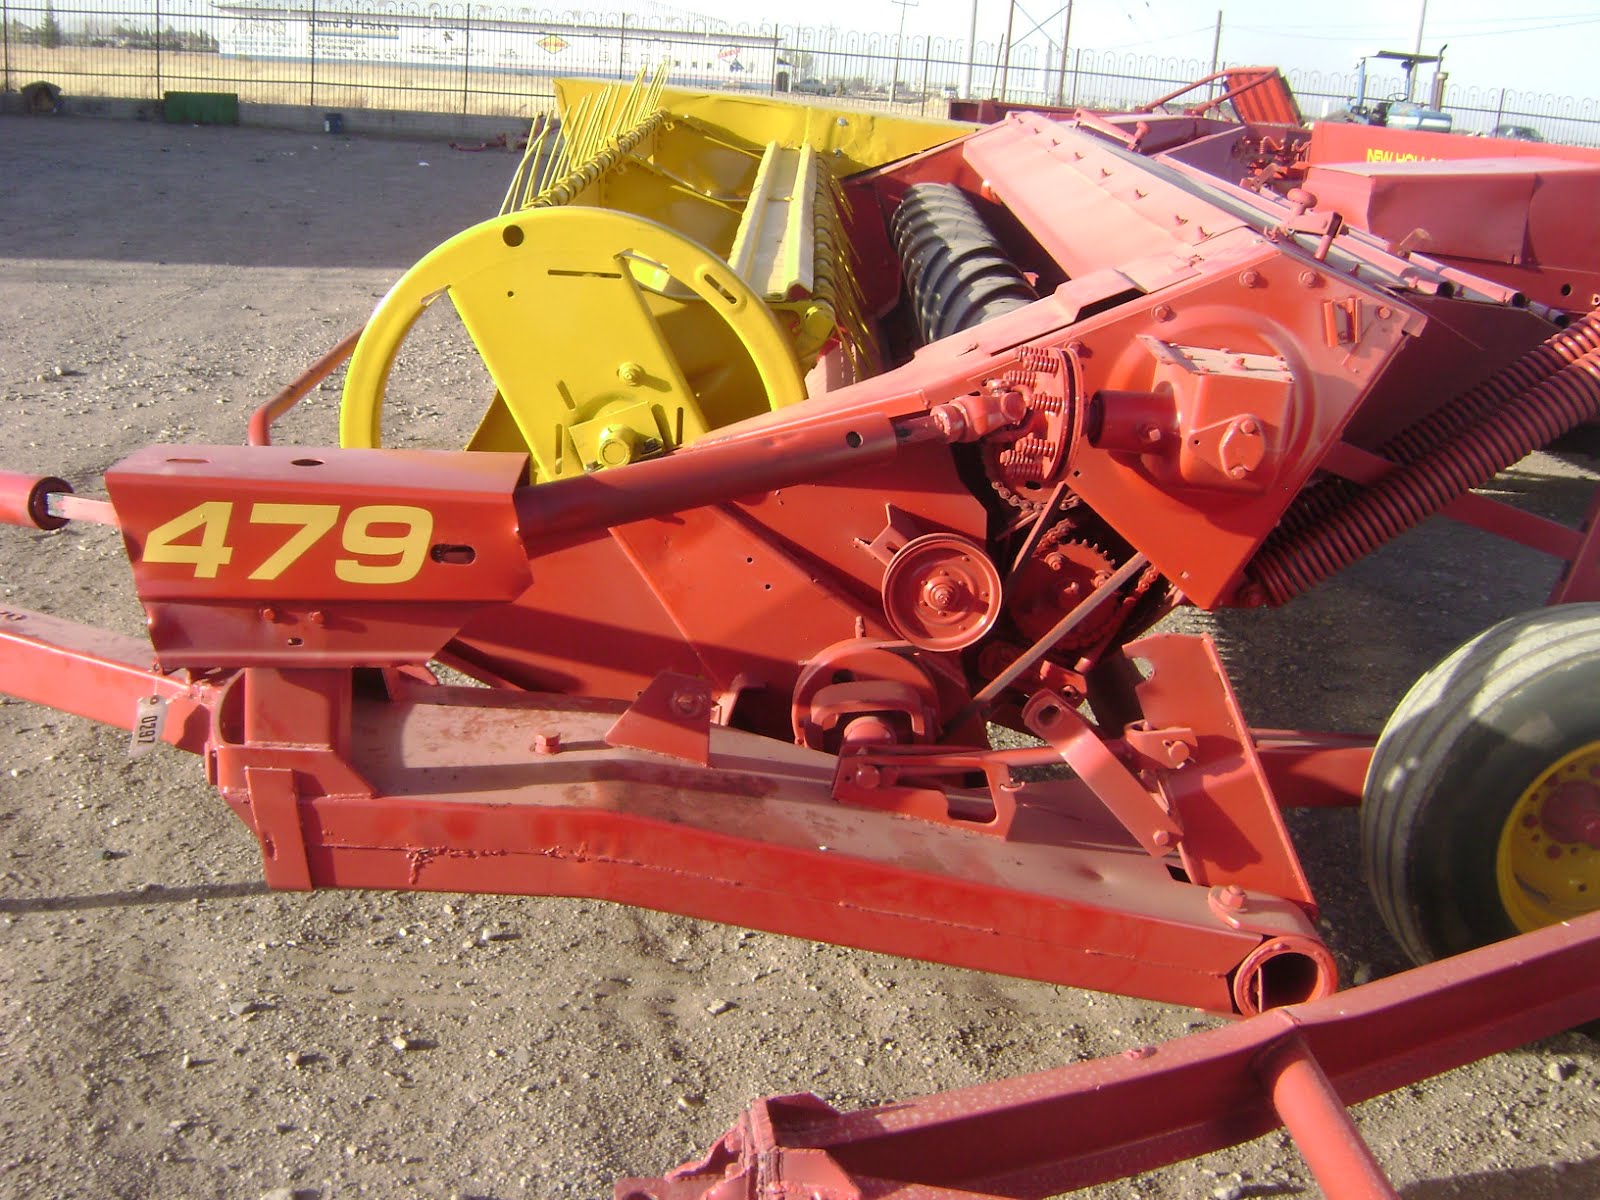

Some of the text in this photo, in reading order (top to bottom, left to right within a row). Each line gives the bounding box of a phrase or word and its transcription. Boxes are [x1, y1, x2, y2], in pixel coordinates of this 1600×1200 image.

[309, 17, 339, 28] Land
[1366, 148, 1394, 163] NEW
[142, 501, 434, 585] 479
[138, 715, 158, 744] 0297
